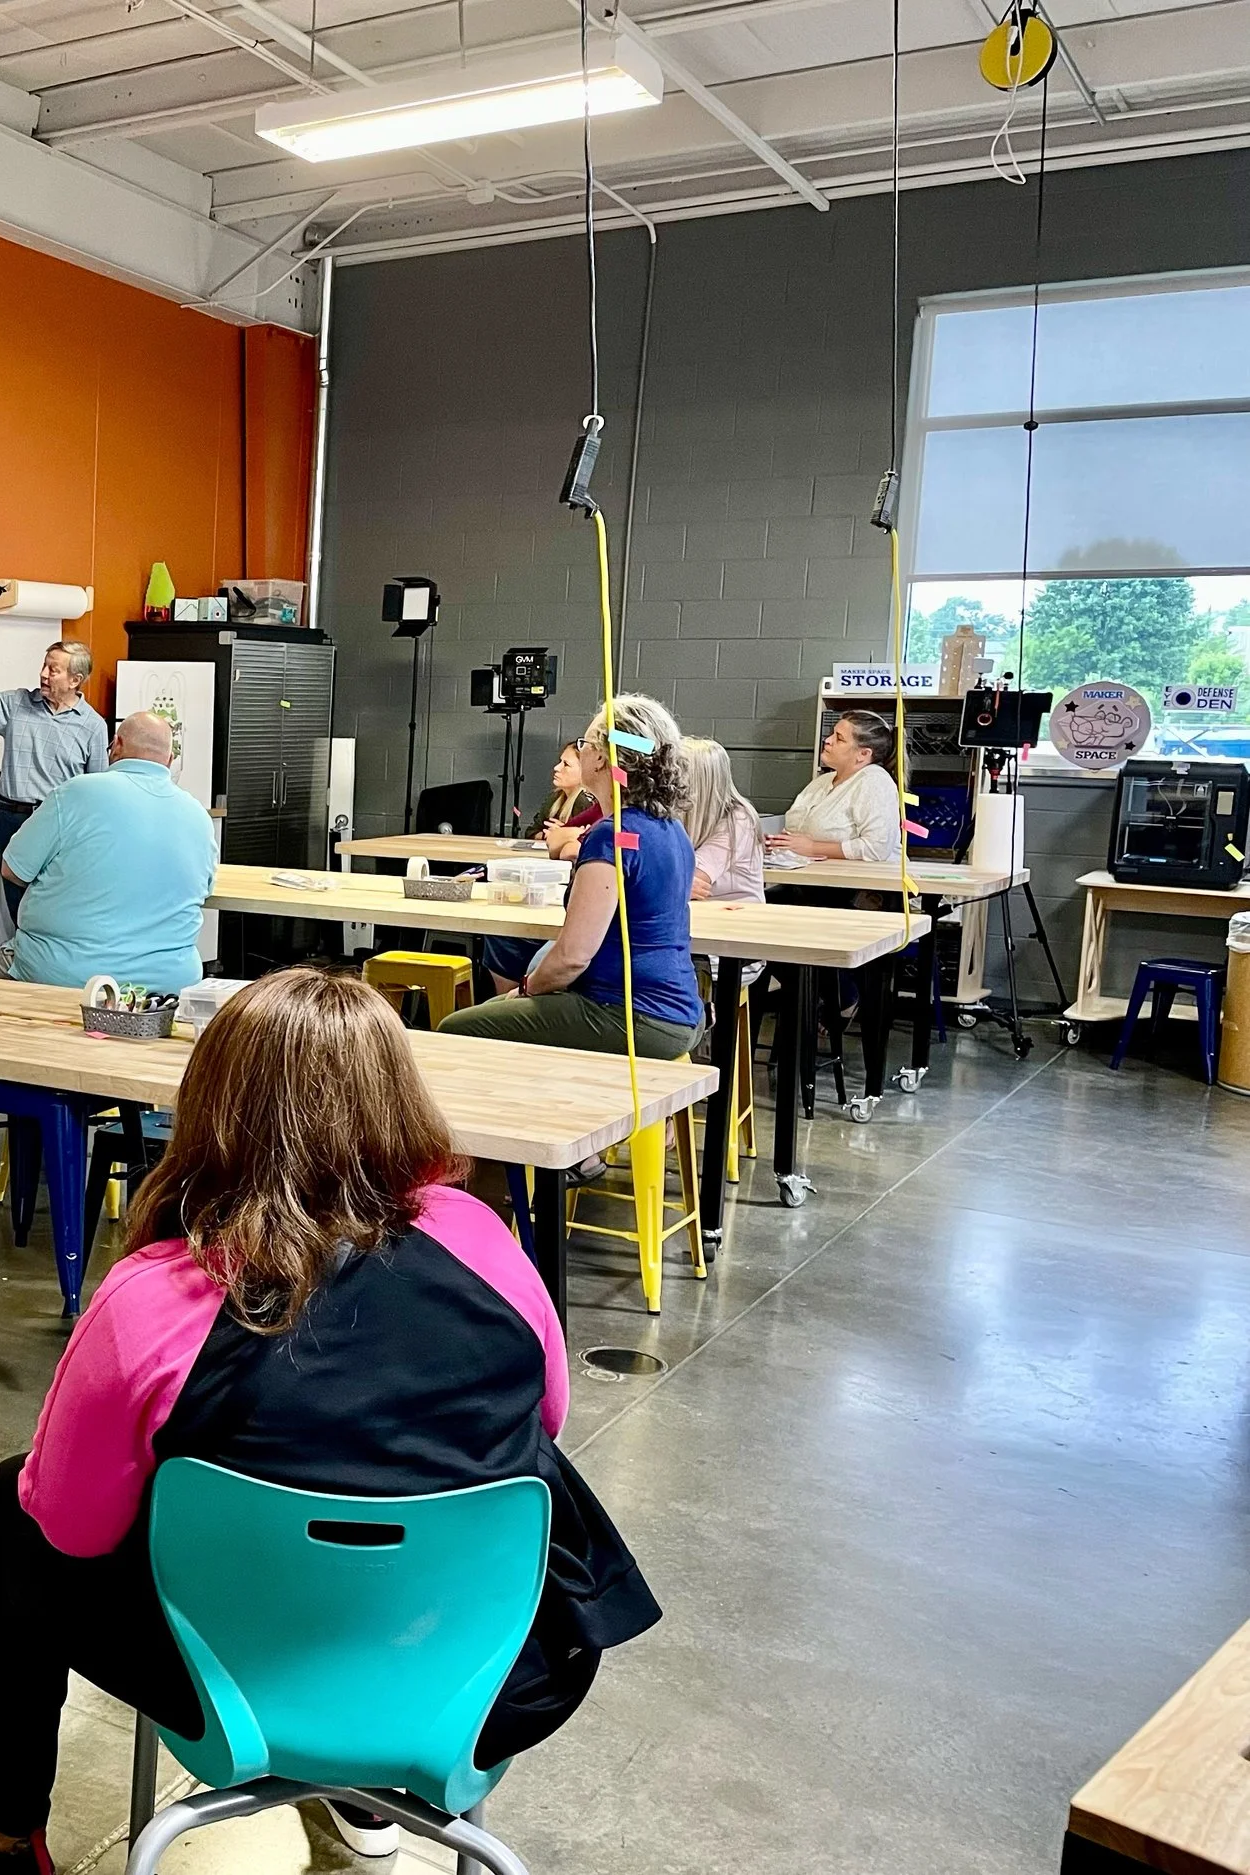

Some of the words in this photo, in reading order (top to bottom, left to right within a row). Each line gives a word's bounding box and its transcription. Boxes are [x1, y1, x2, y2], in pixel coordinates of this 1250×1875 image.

[840, 675, 933, 687] STORAGE
[1083, 691, 1124, 699] MAKER
[1197, 687, 1235, 699] DEFENSE
[1196, 698, 1233, 710] DEN
[1075, 750, 1117, 760] SPACE
